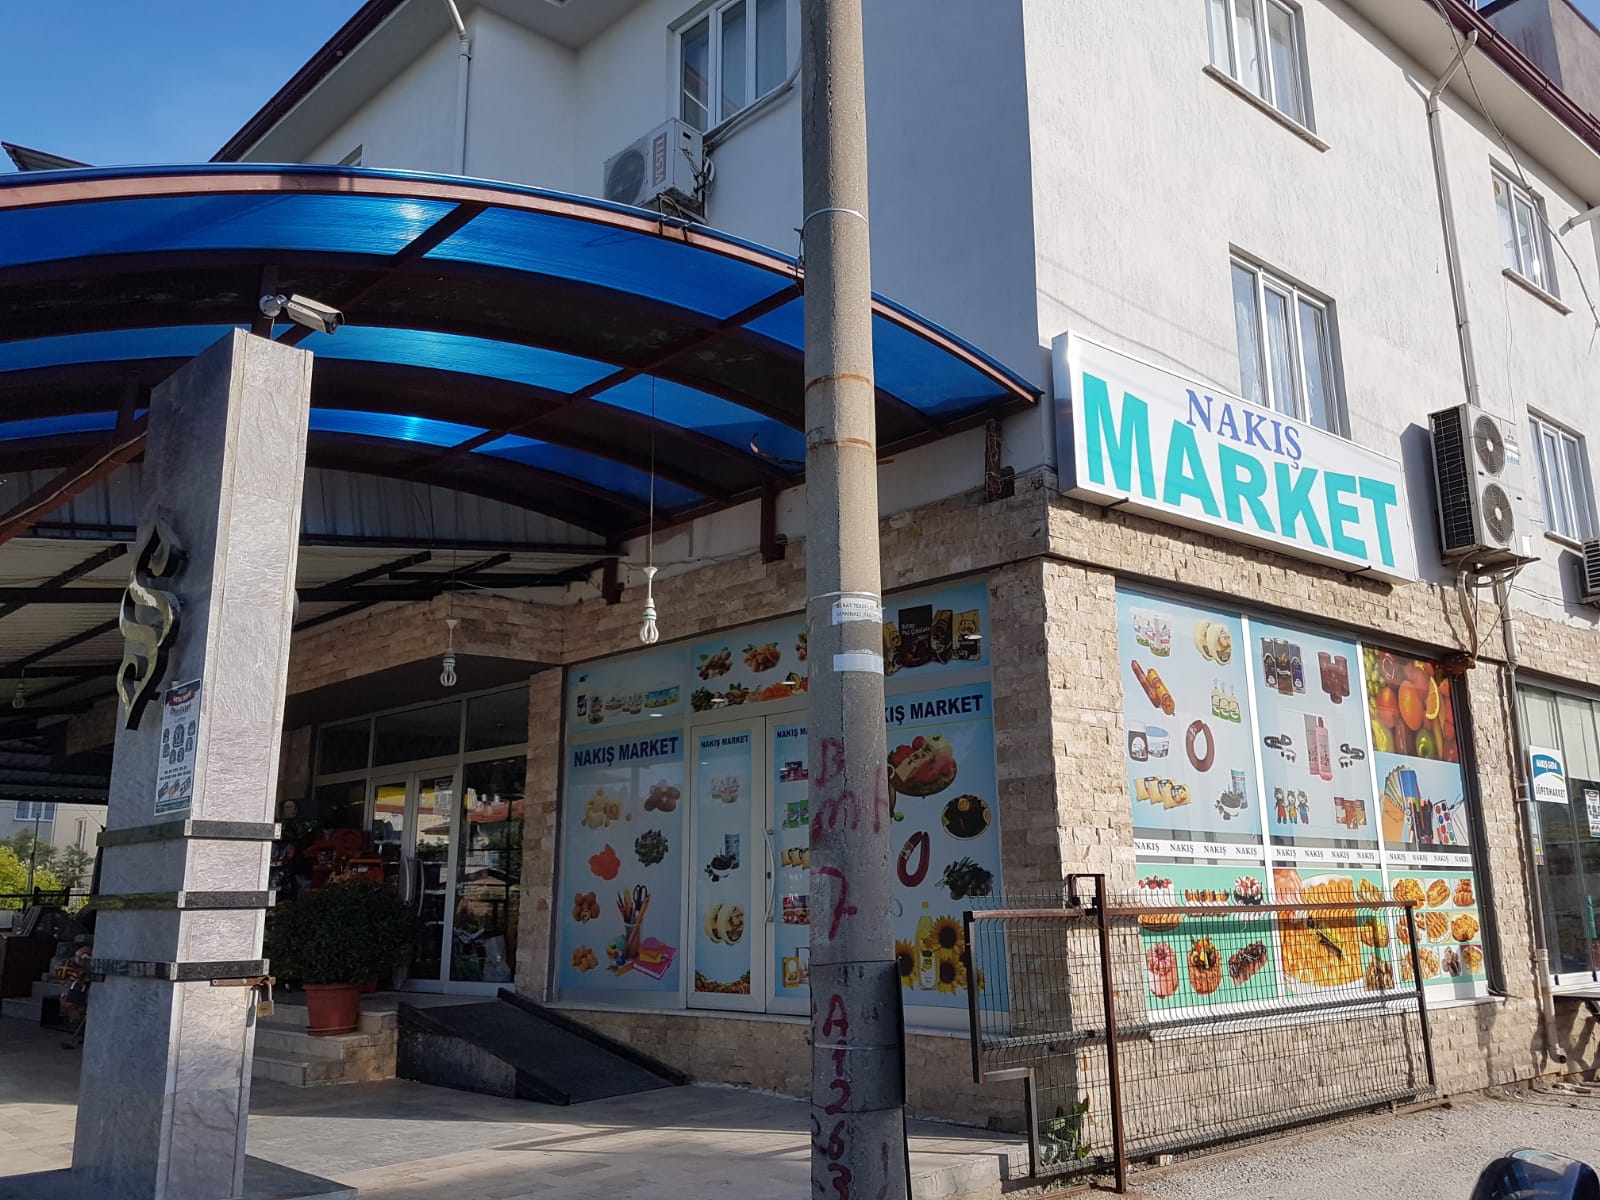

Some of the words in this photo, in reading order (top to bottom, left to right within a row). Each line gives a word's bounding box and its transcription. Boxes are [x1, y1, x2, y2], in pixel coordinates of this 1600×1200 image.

[1185, 389, 1302, 469] NAKIŞ
[1082, 371, 1399, 568] MARKET
[910, 694, 983, 719] MARKET
[701, 738, 720, 749] NAKIŞ
[721, 735, 749, 746] MARKET
[776, 728, 800, 739] NAKIŞ
[573, 746, 615, 768] NAKIŞ
[618, 736, 679, 760] MARKET
[1134, 841, 1160, 853] NAKIŞ
[1170, 843, 1194, 854] NAKIŞ
[1203, 845, 1227, 856] NAKIŞ
[1236, 847, 1258, 856] NAKIŞ
[1276, 848, 1297, 858] NAKIŞ
[1304, 850, 1324, 860] NAKIŞ
[1331, 851, 1350, 859] NAKIŞ
